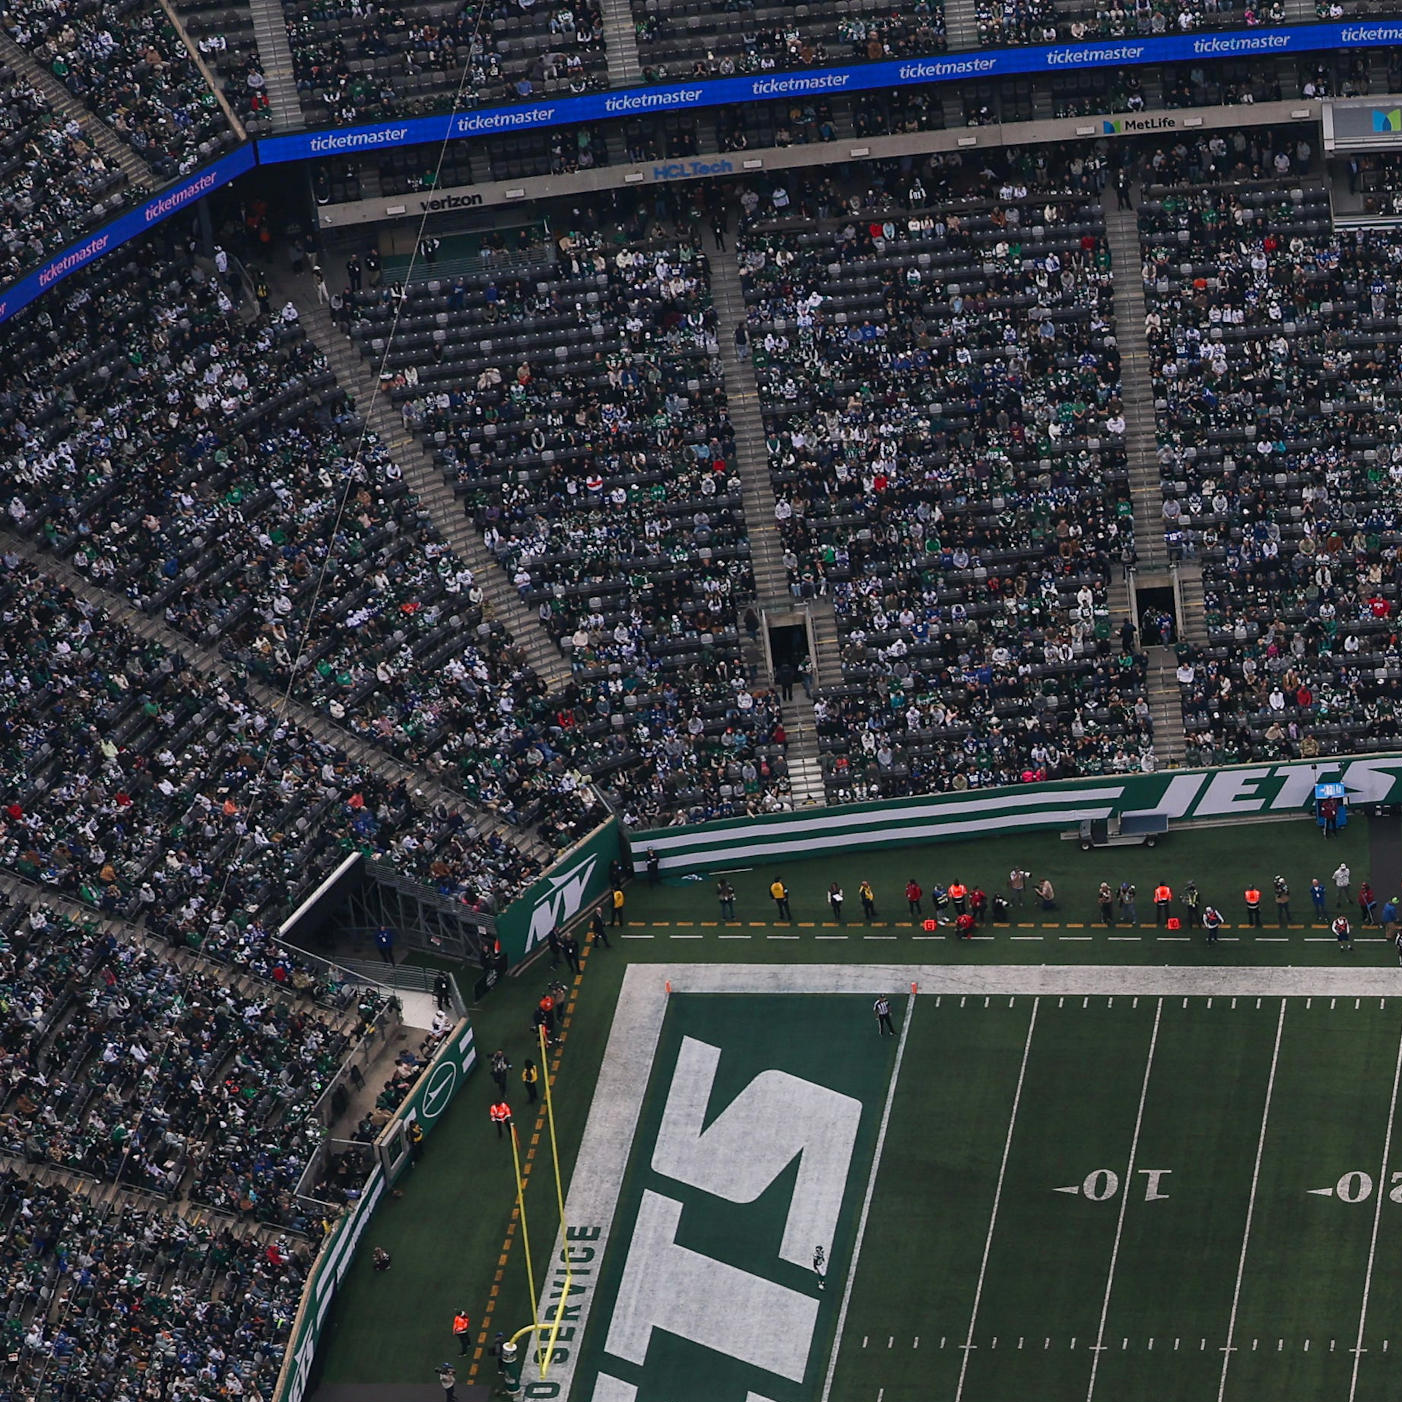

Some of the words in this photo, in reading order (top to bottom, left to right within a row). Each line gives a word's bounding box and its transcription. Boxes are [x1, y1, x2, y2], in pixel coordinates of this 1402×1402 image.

[1193, 34, 1290, 53] ticketmaster
[1047, 46, 1143, 64] ticketmaster
[900, 58, 996, 80] ticketmaster
[752, 74, 849, 95] ticketmaster
[605, 89, 703, 112] ticketmaster
[457, 108, 555, 132] ticketmaster
[1124, 116, 1176, 131] MetLife
[310, 128, 407, 152] ticketmaster
[653, 159, 734, 180] HCLTech
[145, 171, 217, 222] ticketmaster
[419, 192, 483, 212] verizon
[39, 233, 109, 287] ticketmaster
[1083, 1169, 1172, 1201] 10
[533, 1225, 601, 1365] SERVICE
